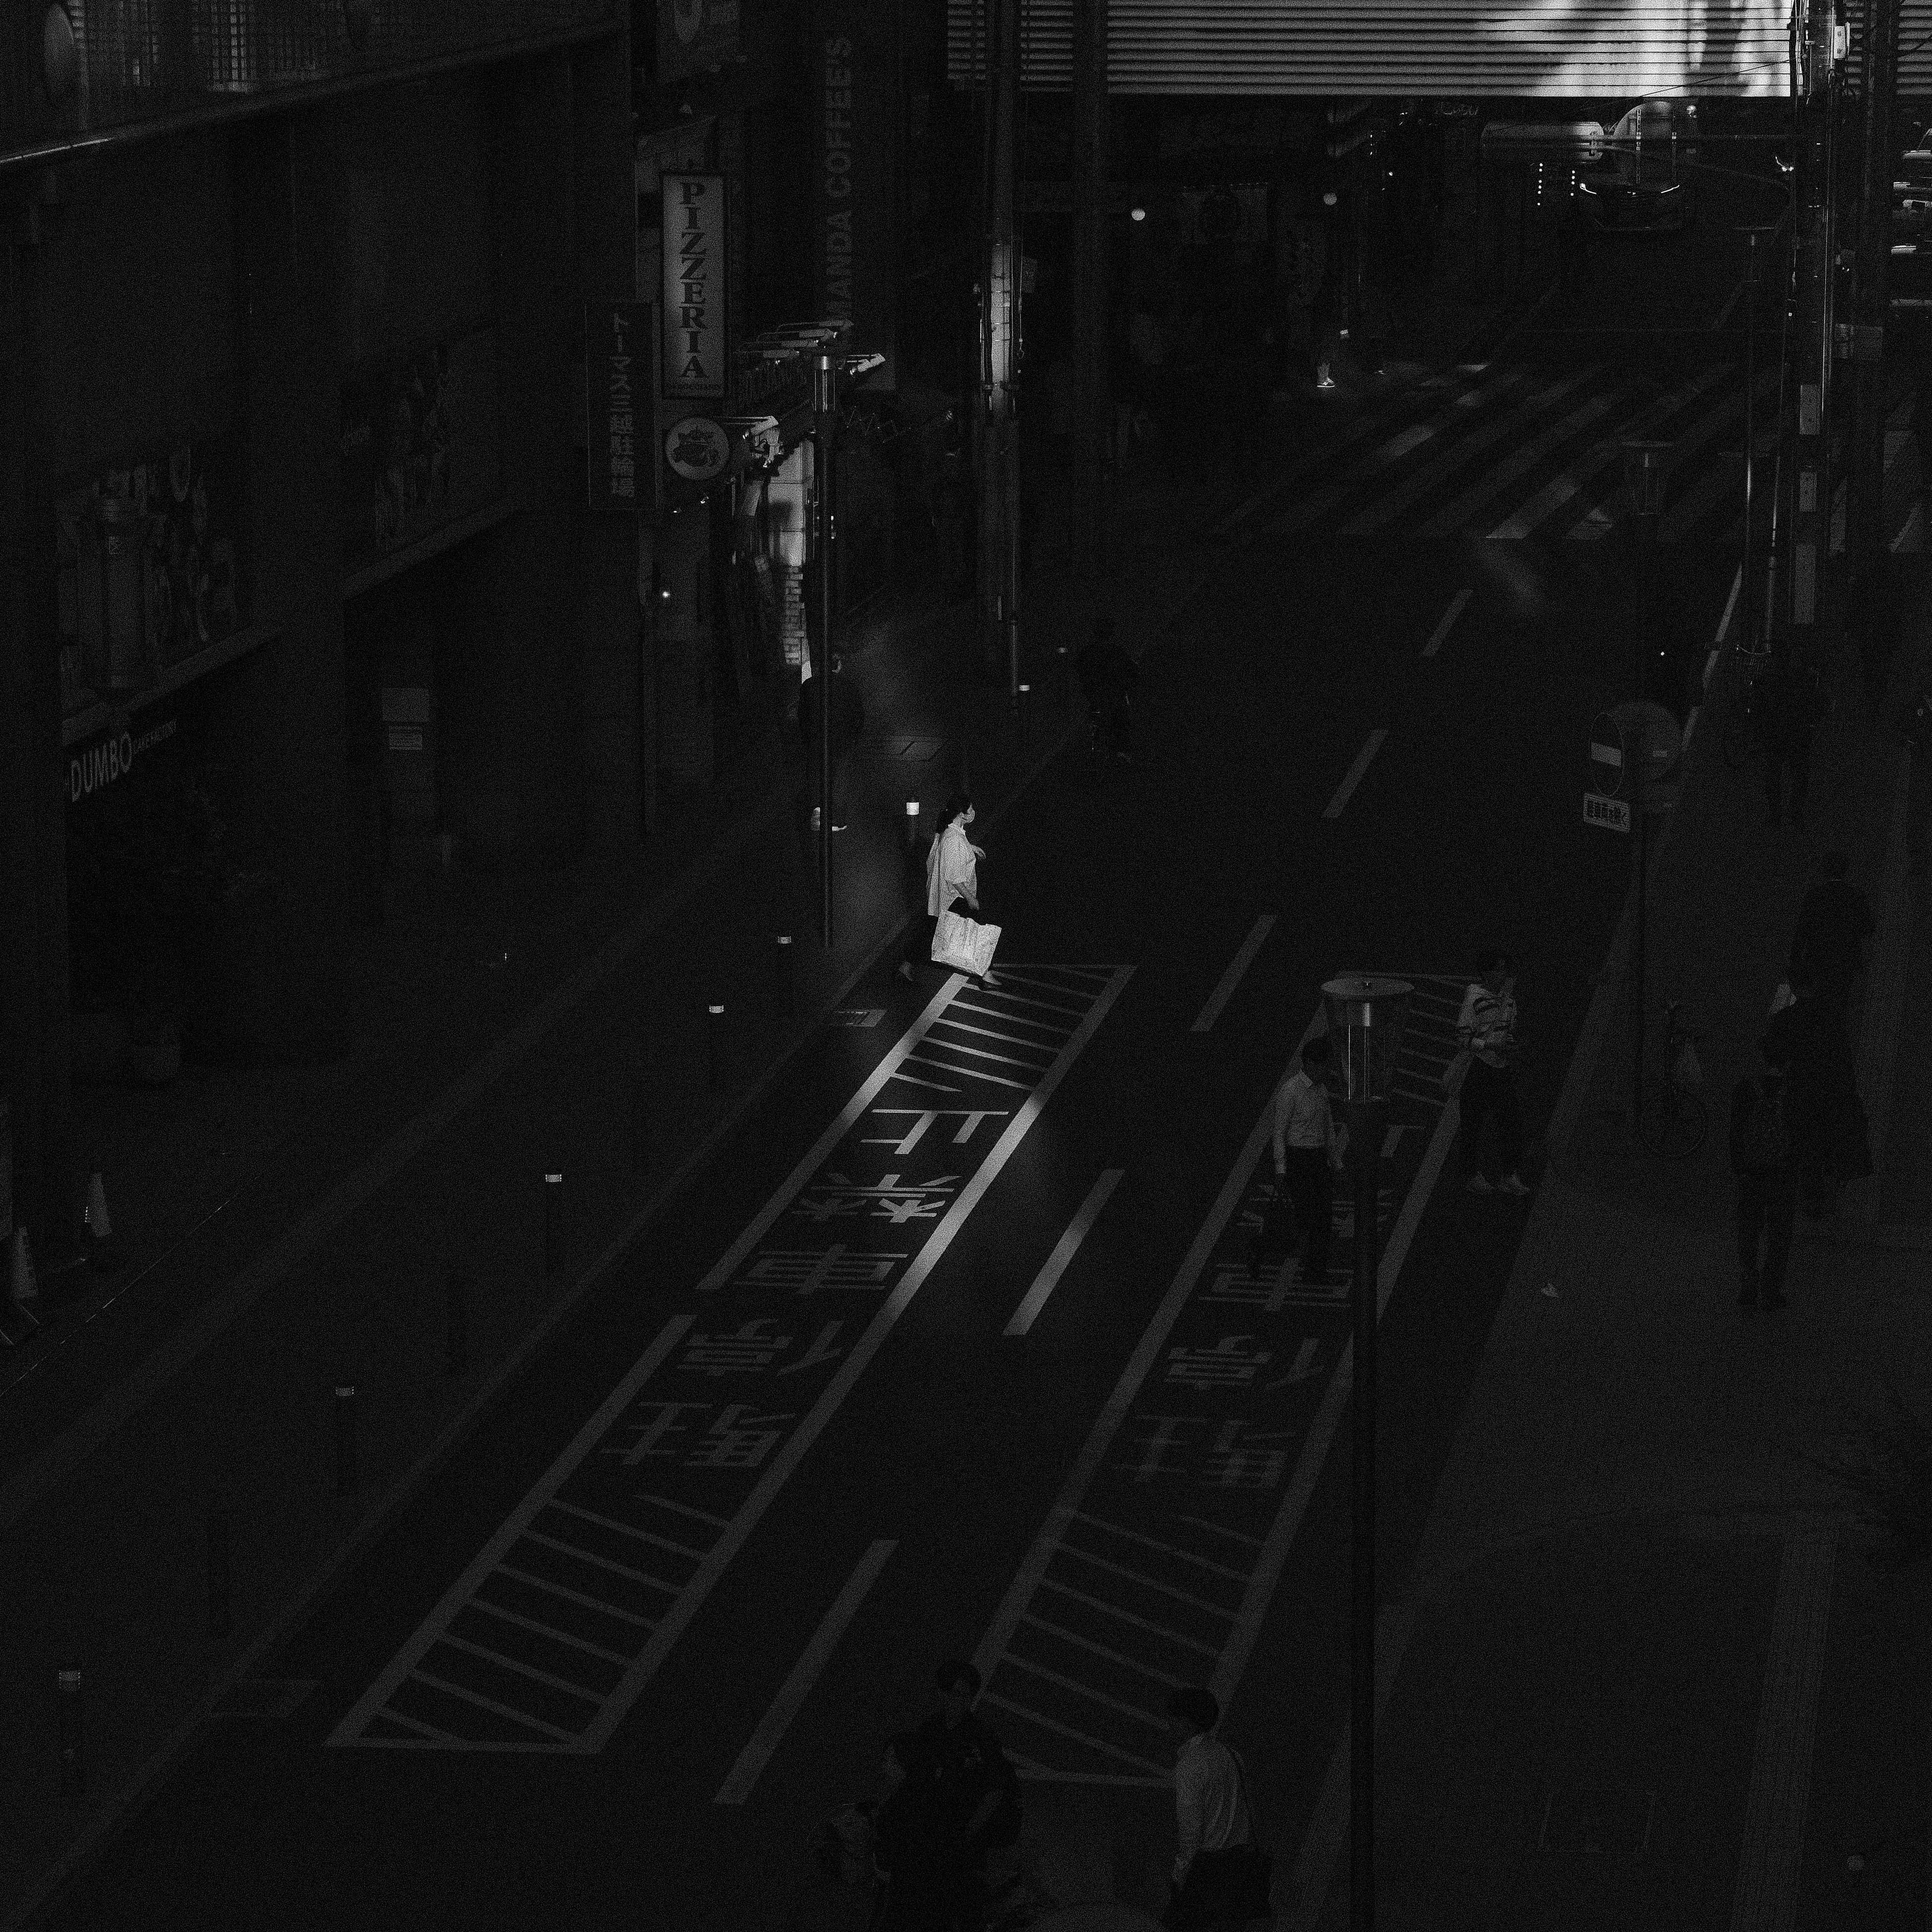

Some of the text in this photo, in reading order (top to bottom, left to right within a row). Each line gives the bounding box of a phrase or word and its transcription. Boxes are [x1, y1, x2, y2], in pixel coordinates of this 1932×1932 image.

[825, 37, 852, 198] COFFEE'S
[679, 182, 709, 378] PIZZERIA
[609, 313, 635, 498] トーマス三越駐輪場
[70, 731, 132, 802] DUMBO
[600, 1108, 1009, 1467] 駐停車禁止
